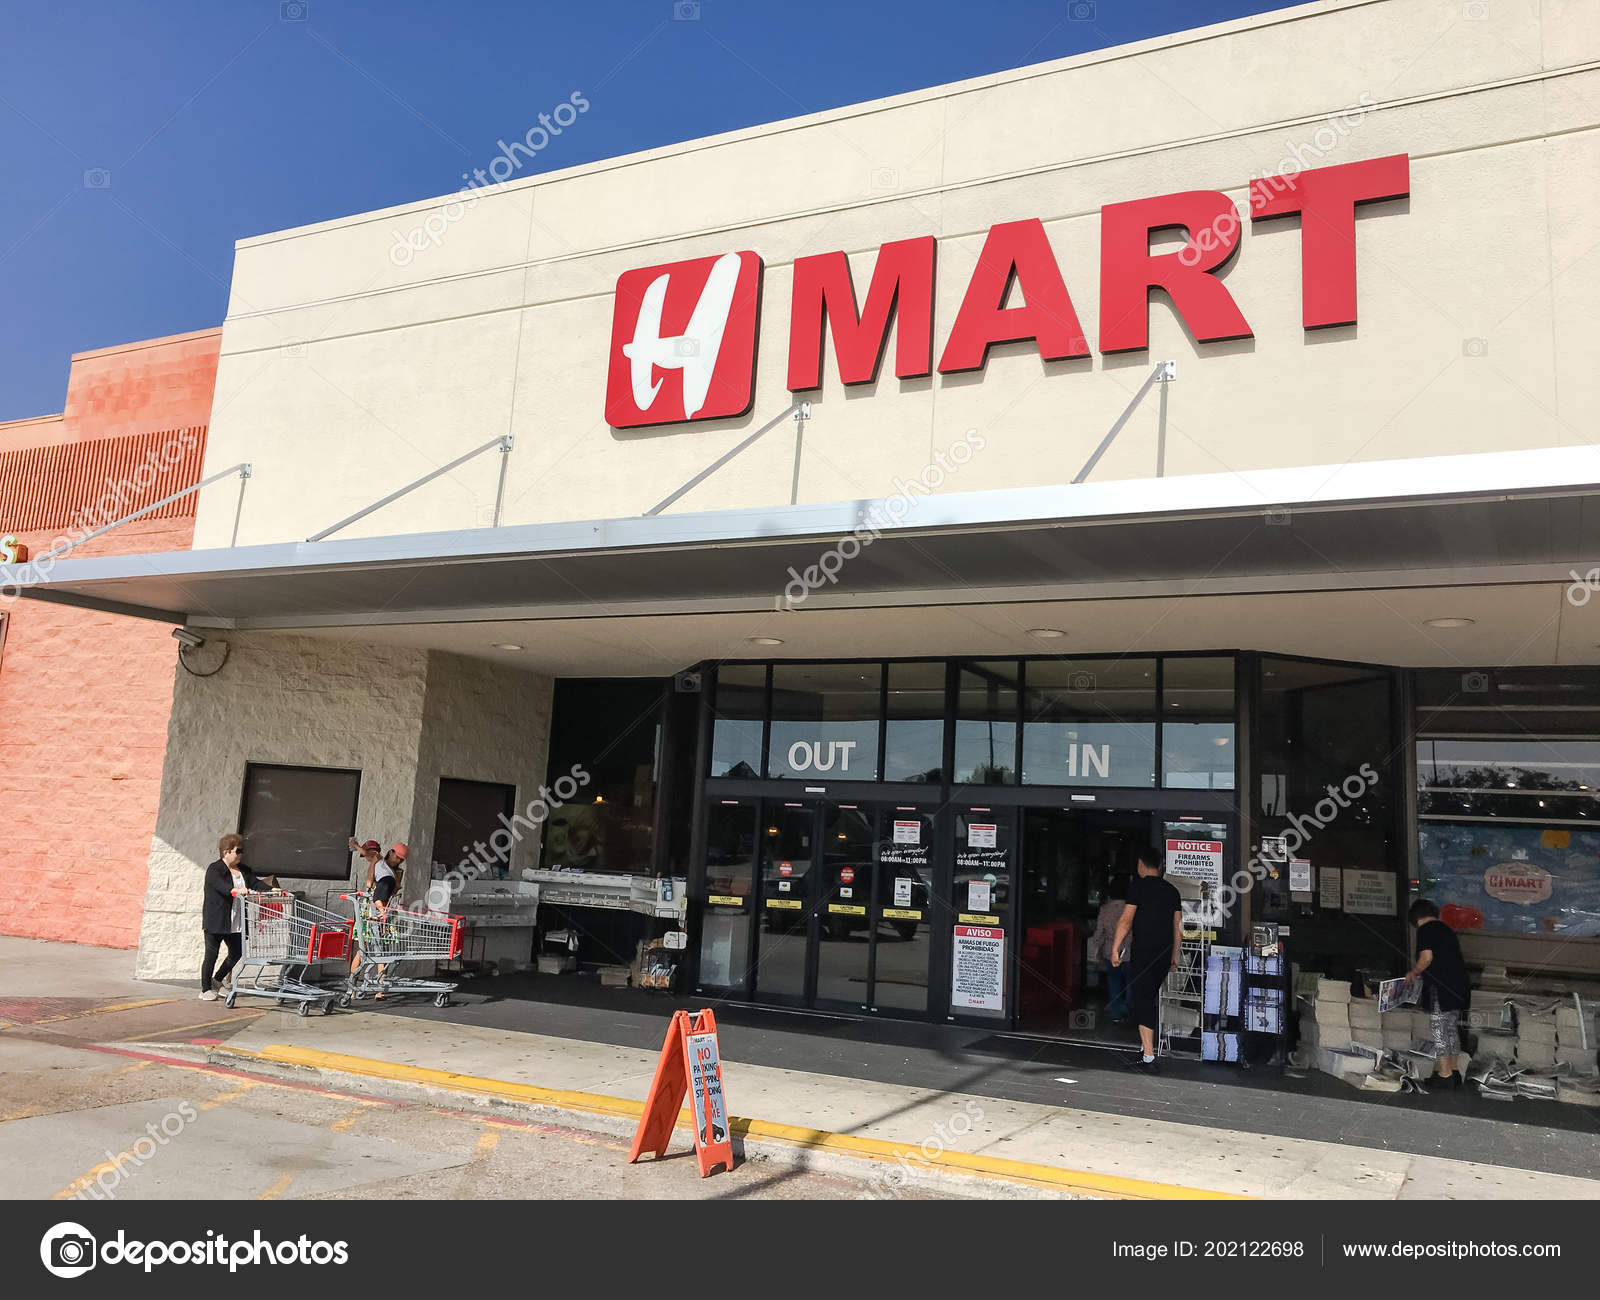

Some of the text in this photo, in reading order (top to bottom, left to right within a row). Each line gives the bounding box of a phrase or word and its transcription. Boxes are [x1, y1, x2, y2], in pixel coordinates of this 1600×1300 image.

[622, 153, 1410, 420] H MART
[788, 741, 856, 771] OUT
[1069, 743, 1110, 777] IN
[1177, 842, 1212, 851] NOTICE
[1178, 853, 1211, 861] FIREARMS
[1174, 859, 1214, 867] PROHIBITED
[1505, 877, 1545, 889] MART
[966, 928, 992, 937] AVISO
[983, 940, 1000, 948] FUEGO
[697, 1047, 711, 1060] NO
